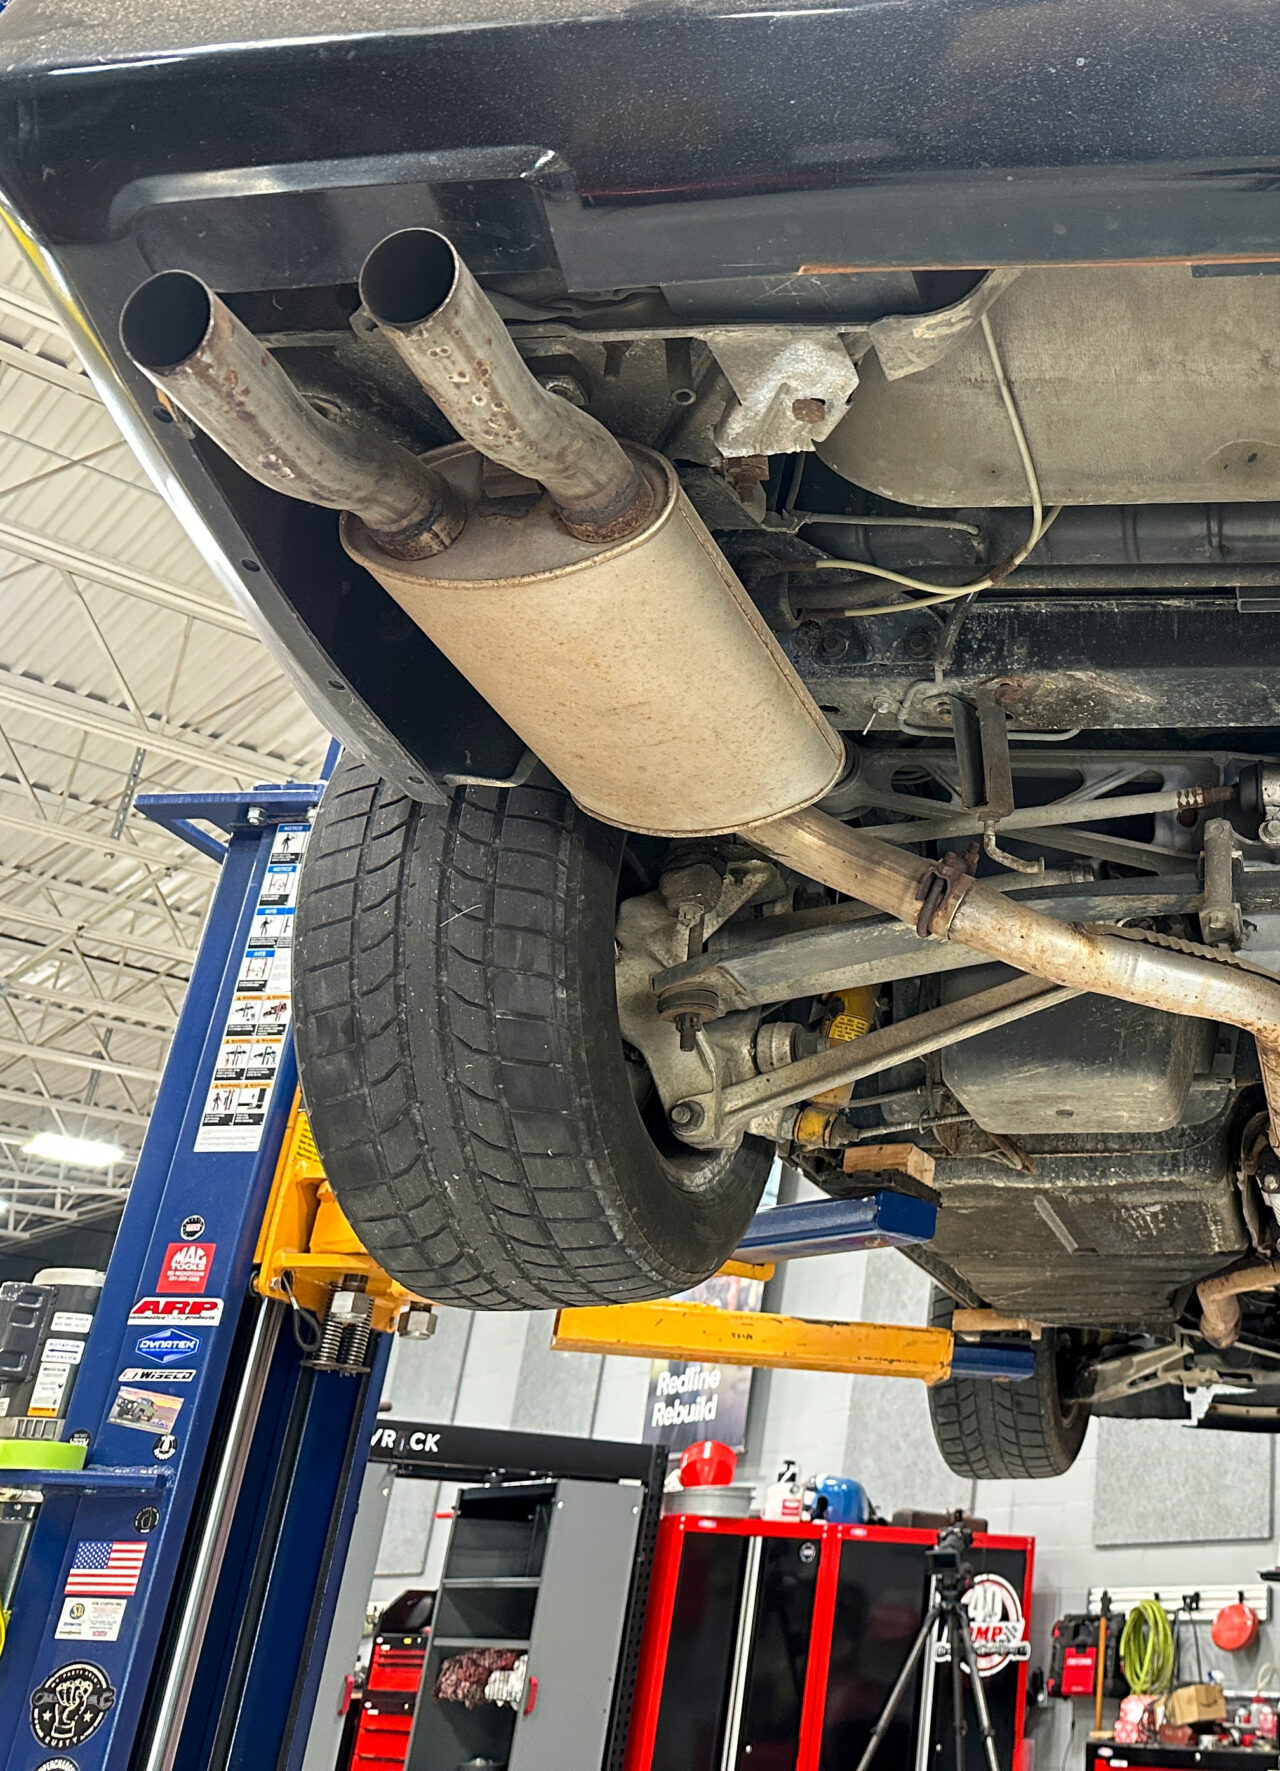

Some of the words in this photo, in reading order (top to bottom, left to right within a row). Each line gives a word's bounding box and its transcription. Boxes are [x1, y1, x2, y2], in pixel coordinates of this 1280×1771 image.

[170, 1246, 207, 1264] MAC
[132, 1301, 218, 1314] ARP
[139, 1340, 196, 1349] DYNATEK
[656, 1366, 721, 1396] Redline
[651, 1394, 718, 1428] Rebuild
[370, 1428, 441, 1453] RCK
[44, 1736, 78, 1748] RUSTY
